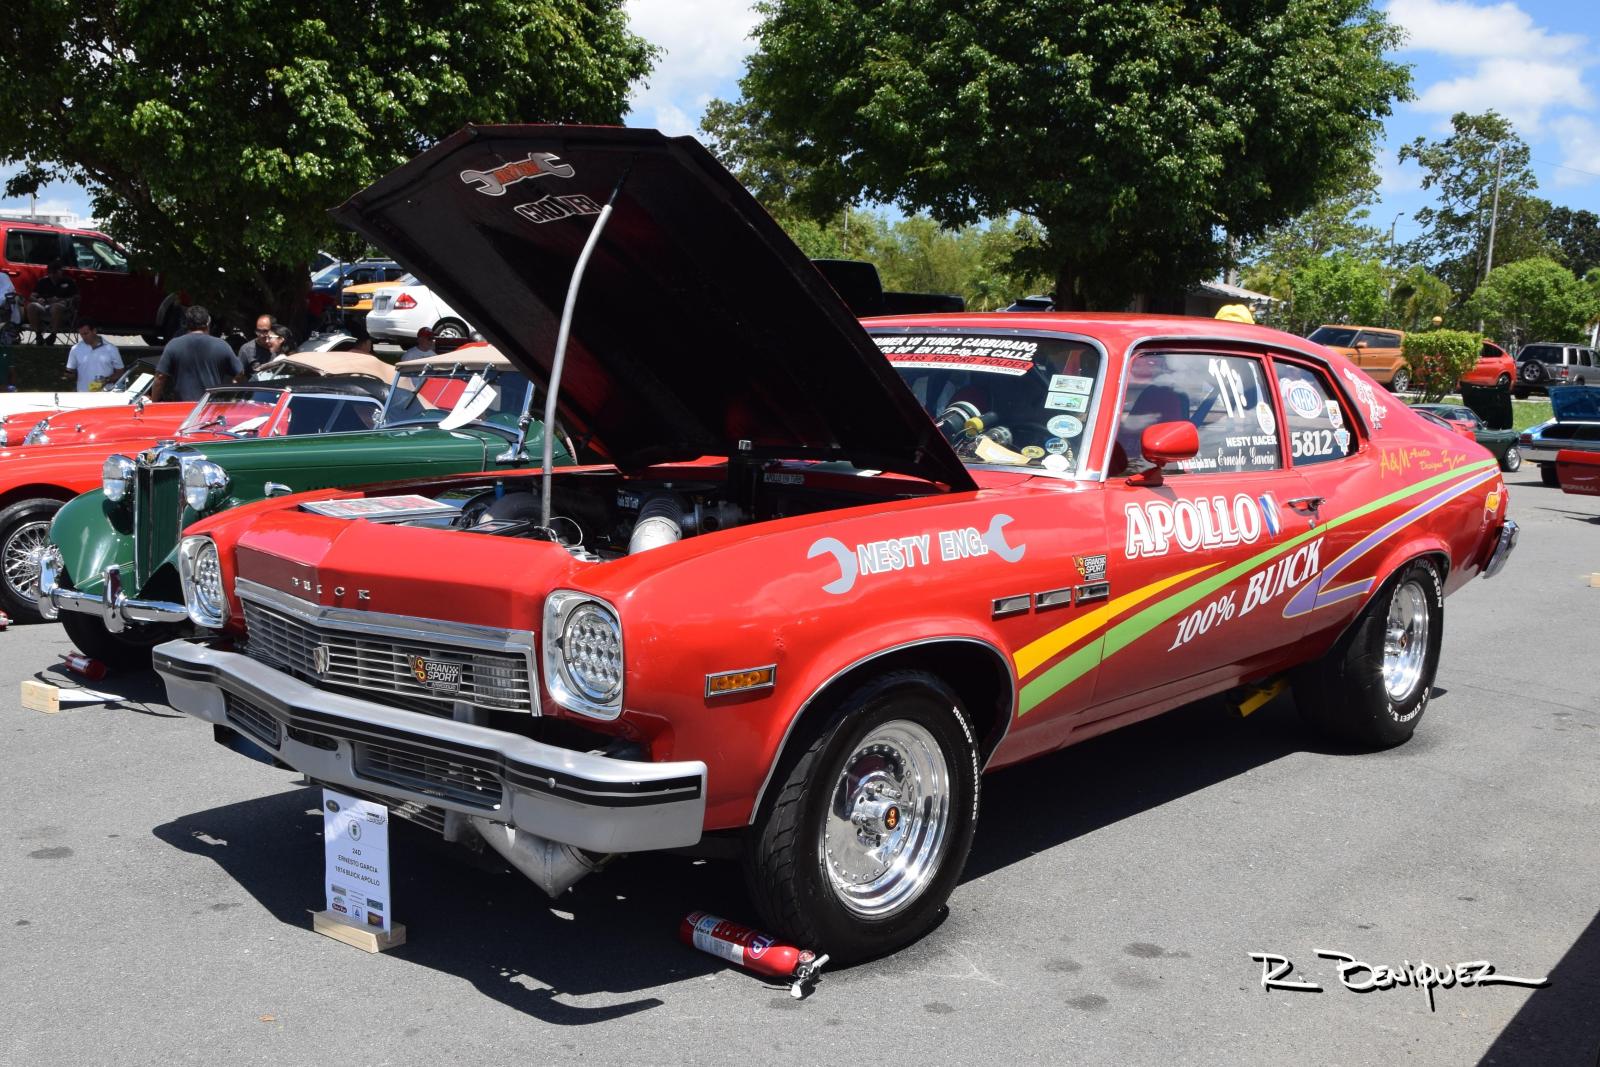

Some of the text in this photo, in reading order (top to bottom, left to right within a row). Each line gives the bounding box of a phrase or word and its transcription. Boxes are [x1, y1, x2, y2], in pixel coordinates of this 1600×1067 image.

[872, 337, 907, 347] RIMER
[906, 337, 924, 346] V8
[922, 337, 962, 347] TURBO
[930, 355, 976, 364] RECORD
[981, 358, 1030, 370] HOLDER
[1225, 435, 1278, 448] NESTY RACER
[1291, 429, 1333, 457] 5812
[1217, 447, 1247, 467] Ernesto
[1249, 446, 1276, 466] Garcia
[1125, 493, 1261, 559] APOLLO
[856, 527, 989, 576] NESTY ENG.
[291, 576, 372, 600] BUICK
[1168, 537, 1326, 652] 100% BUICK
[425, 662, 450, 673] GRAN
[427, 671, 458, 682] SPORT
[952, 706, 979, 821] MICKEY THOMPSON
[351, 848, 362, 856] 24D
[336, 855, 378, 873] ERNESTO GARCIA
[345, 869, 361, 880] BUICK
[361, 875, 381, 887] APOLLO
